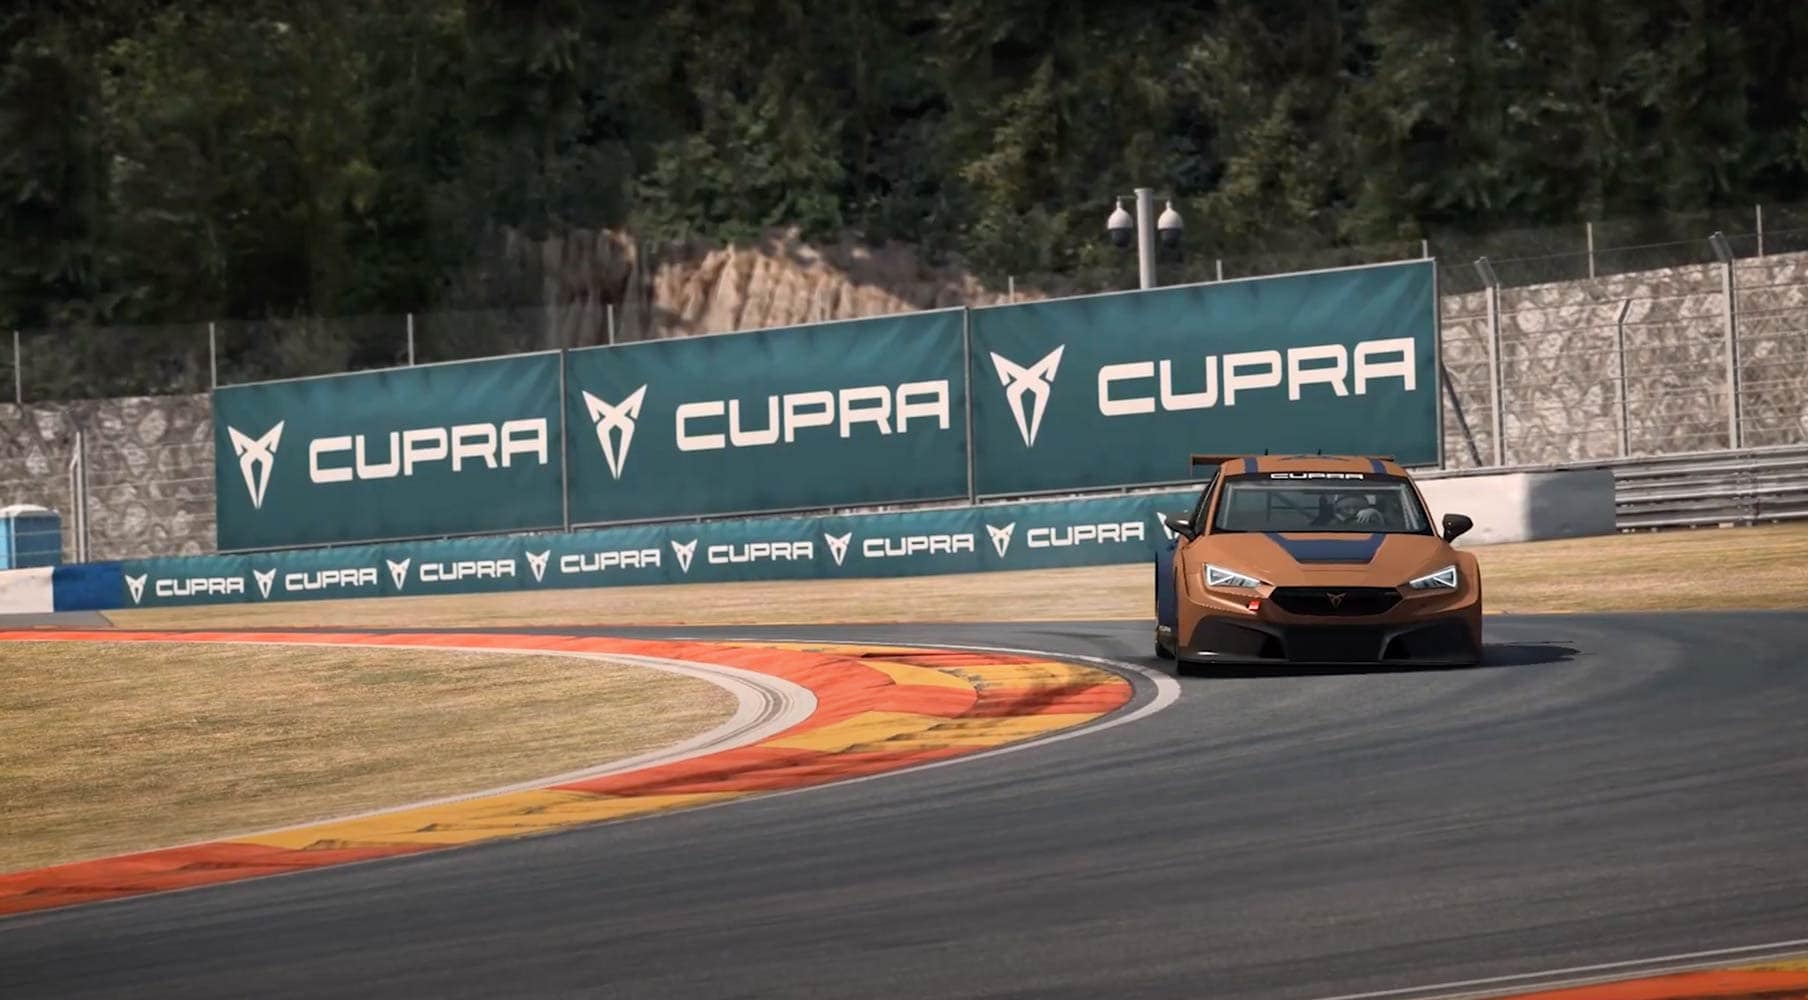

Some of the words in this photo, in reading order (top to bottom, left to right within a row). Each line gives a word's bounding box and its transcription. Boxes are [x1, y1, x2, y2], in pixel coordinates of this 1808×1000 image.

[1098, 337, 1416, 416] CUPRA
[676, 380, 949, 451] CUPRA
[309, 417, 547, 483] CUPRA
[1270, 472, 1364, 480] CUPRA
[863, 533, 974, 557] CUPRA
[1027, 521, 1144, 548] CUPRA
[560, 548, 660, 573] CUPRA
[708, 541, 814, 564] CUPRA
[285, 567, 377, 591] CUPRA
[420, 559, 516, 582] CUPRA
[156, 577, 244, 597] CUPRA
